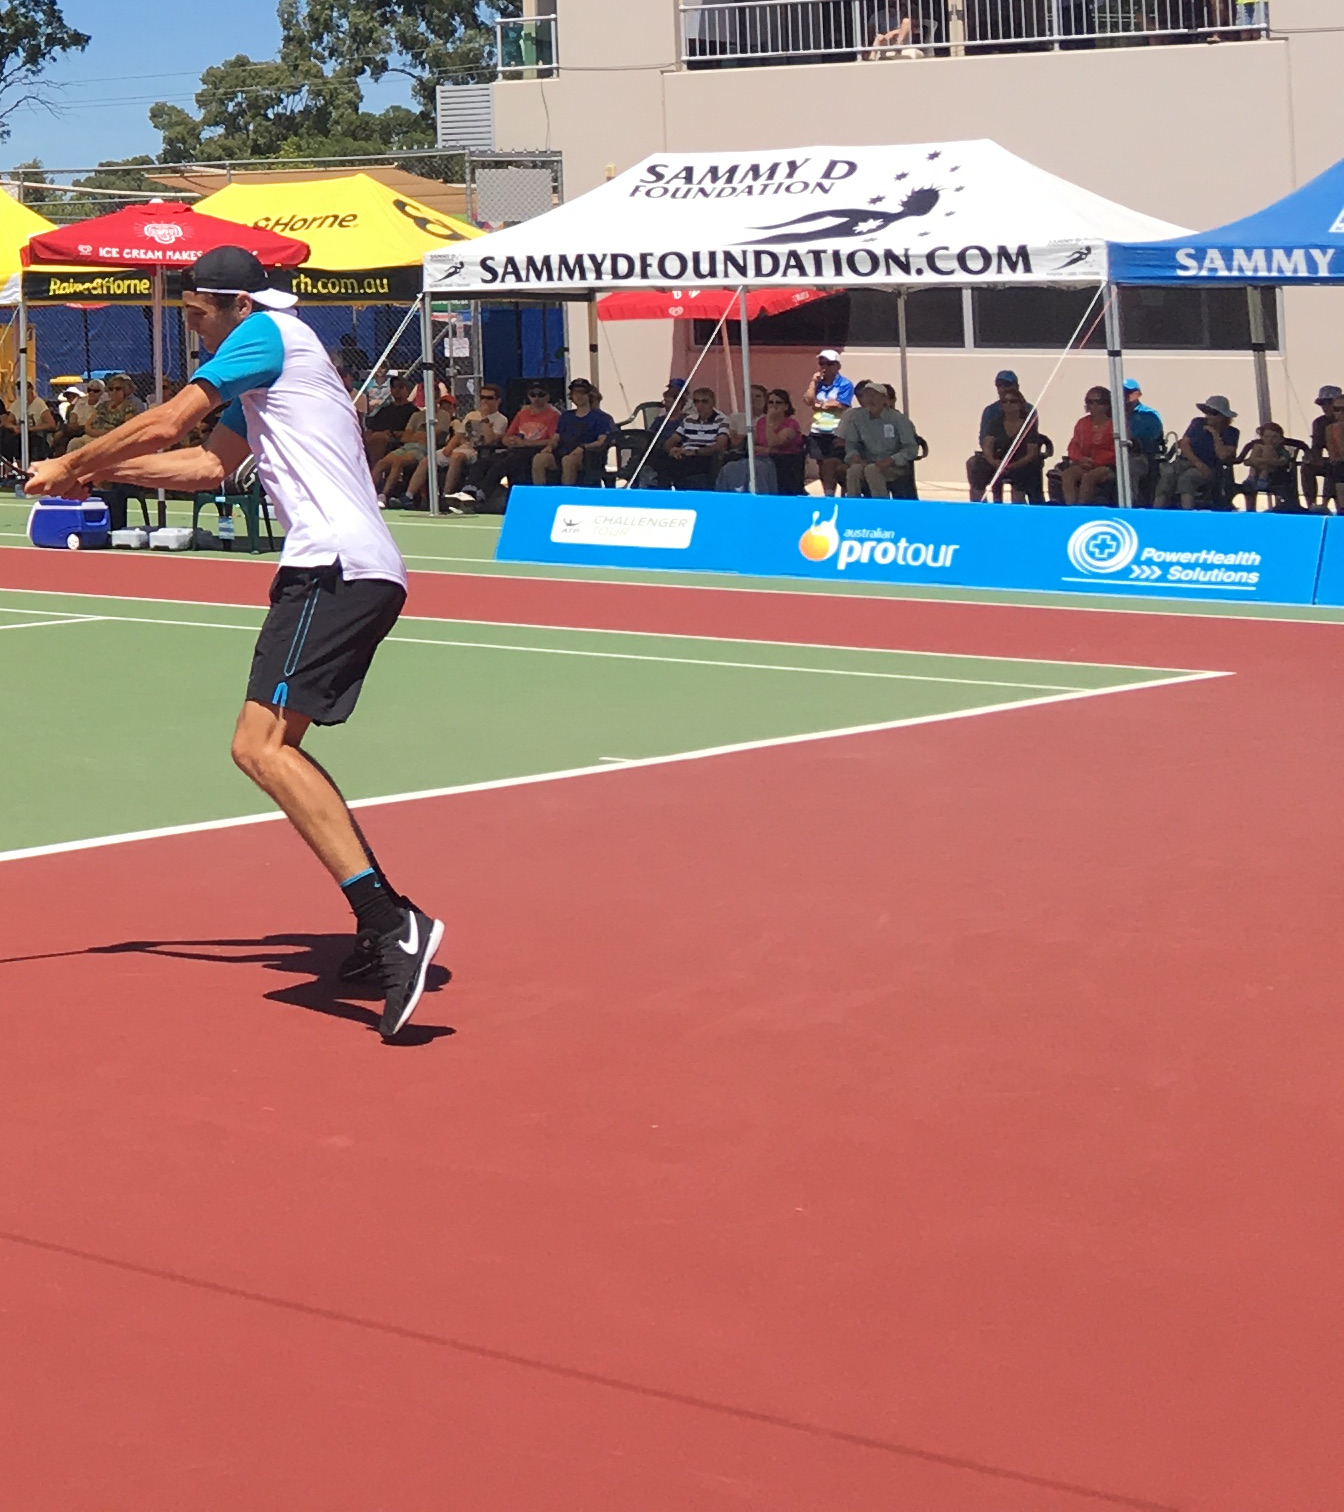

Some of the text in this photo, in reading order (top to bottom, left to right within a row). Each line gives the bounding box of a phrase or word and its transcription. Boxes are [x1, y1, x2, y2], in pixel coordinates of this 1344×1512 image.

[639, 157, 858, 186] SAMMY D
[628, 180, 836, 199] FOUNDATION
[98, 247, 203, 261] ICE CREAM MAKES
[479, 243, 1034, 284] SAMMYDFOUNDATION.COM
[1175, 247, 1336, 277] SAMMY
[291, 273, 389, 294] rh.com.au
[593, 515, 689, 528] CHALLENGER
[843, 527, 896, 539] australian
[837, 537, 961, 571] protour
[1140, 547, 1262, 566] PowerHealth
[1166, 565, 1261, 584] Solutions
